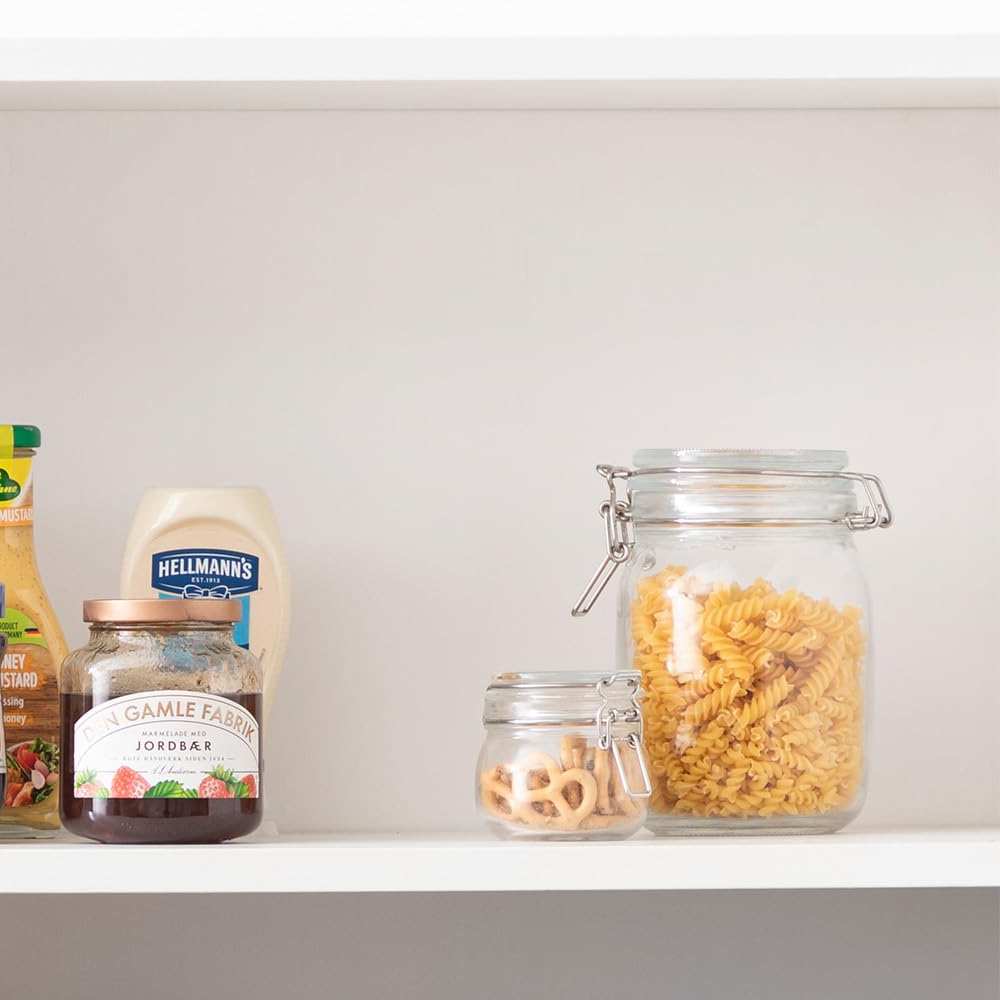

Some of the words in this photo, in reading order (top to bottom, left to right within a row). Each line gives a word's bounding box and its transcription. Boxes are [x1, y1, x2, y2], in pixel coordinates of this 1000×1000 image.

[158, 557, 253, 580] HELLMANN'S
[124, 700, 197, 722] GAMLE
[201, 703, 256, 743] FABRIK
[136, 740, 212, 751] JORDBÆR
